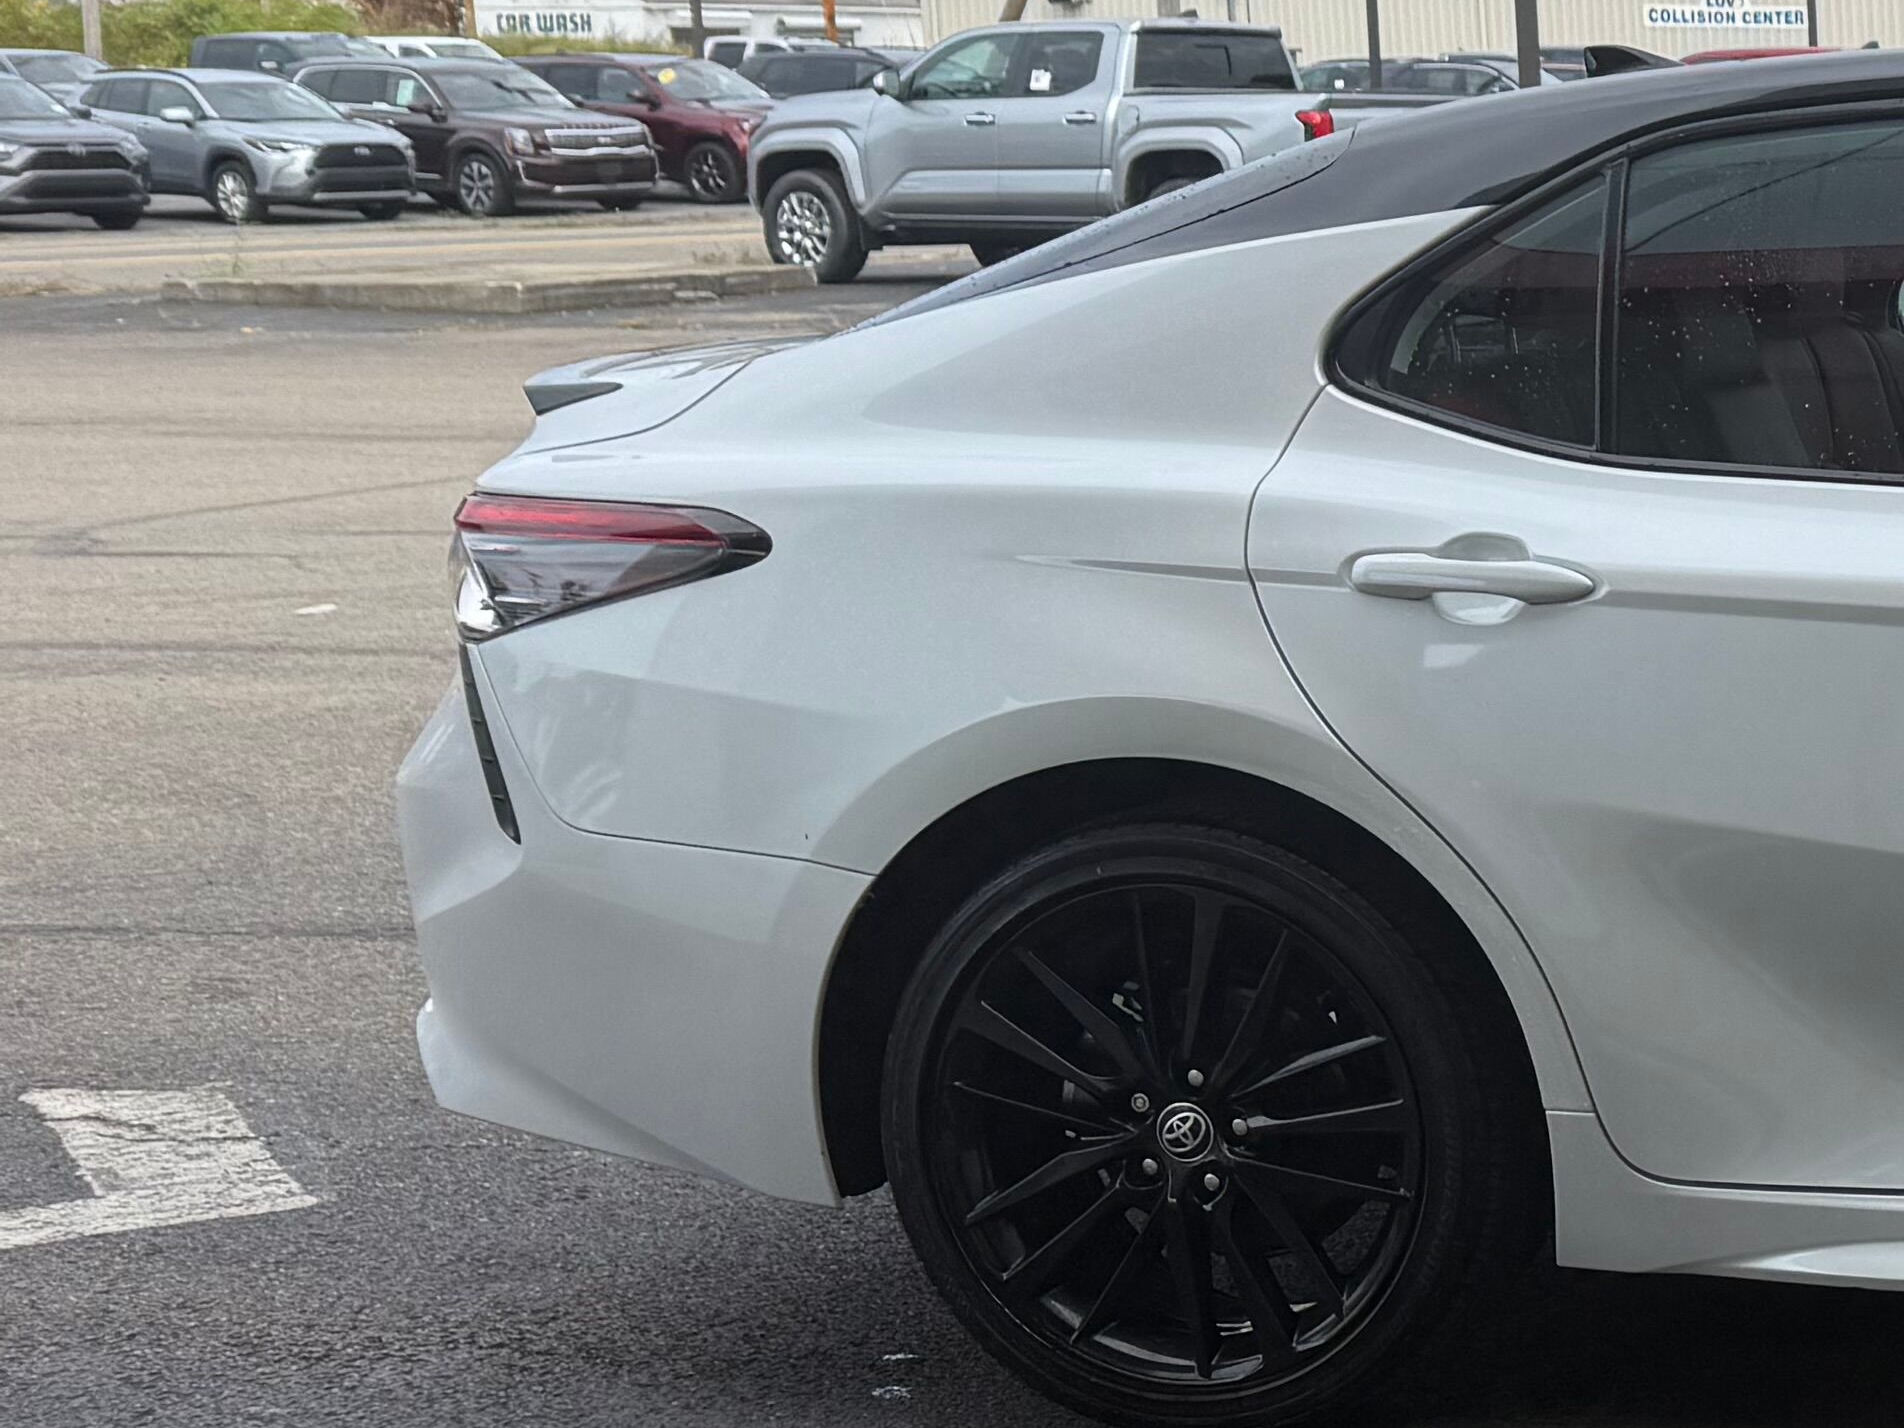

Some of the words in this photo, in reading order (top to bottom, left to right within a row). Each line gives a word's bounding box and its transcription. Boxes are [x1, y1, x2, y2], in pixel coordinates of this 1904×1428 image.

[496, 13, 532, 32] CAR
[536, 12, 592, 32] WASH
[1649, 8, 1736, 24] COLLISION
[1742, 10, 1805, 24] CENTER
